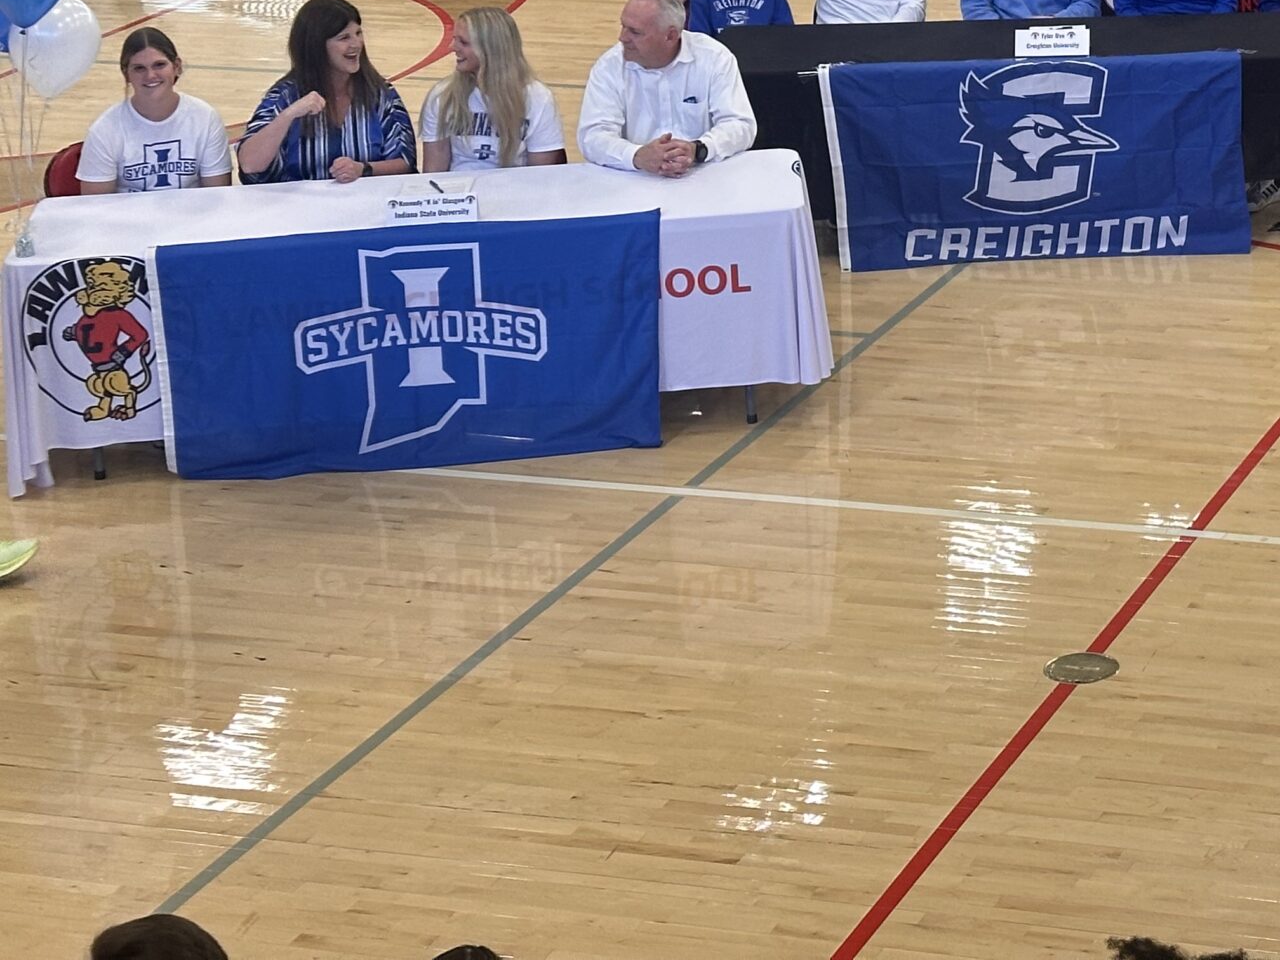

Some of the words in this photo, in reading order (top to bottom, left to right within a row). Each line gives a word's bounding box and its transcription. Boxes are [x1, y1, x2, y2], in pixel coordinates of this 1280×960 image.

[126, 161, 197, 179] SYCAMORES
[904, 214, 1189, 262] CREIGHTON
[659, 263, 752, 299] OOL
[305, 307, 539, 364] SYCAMORES
